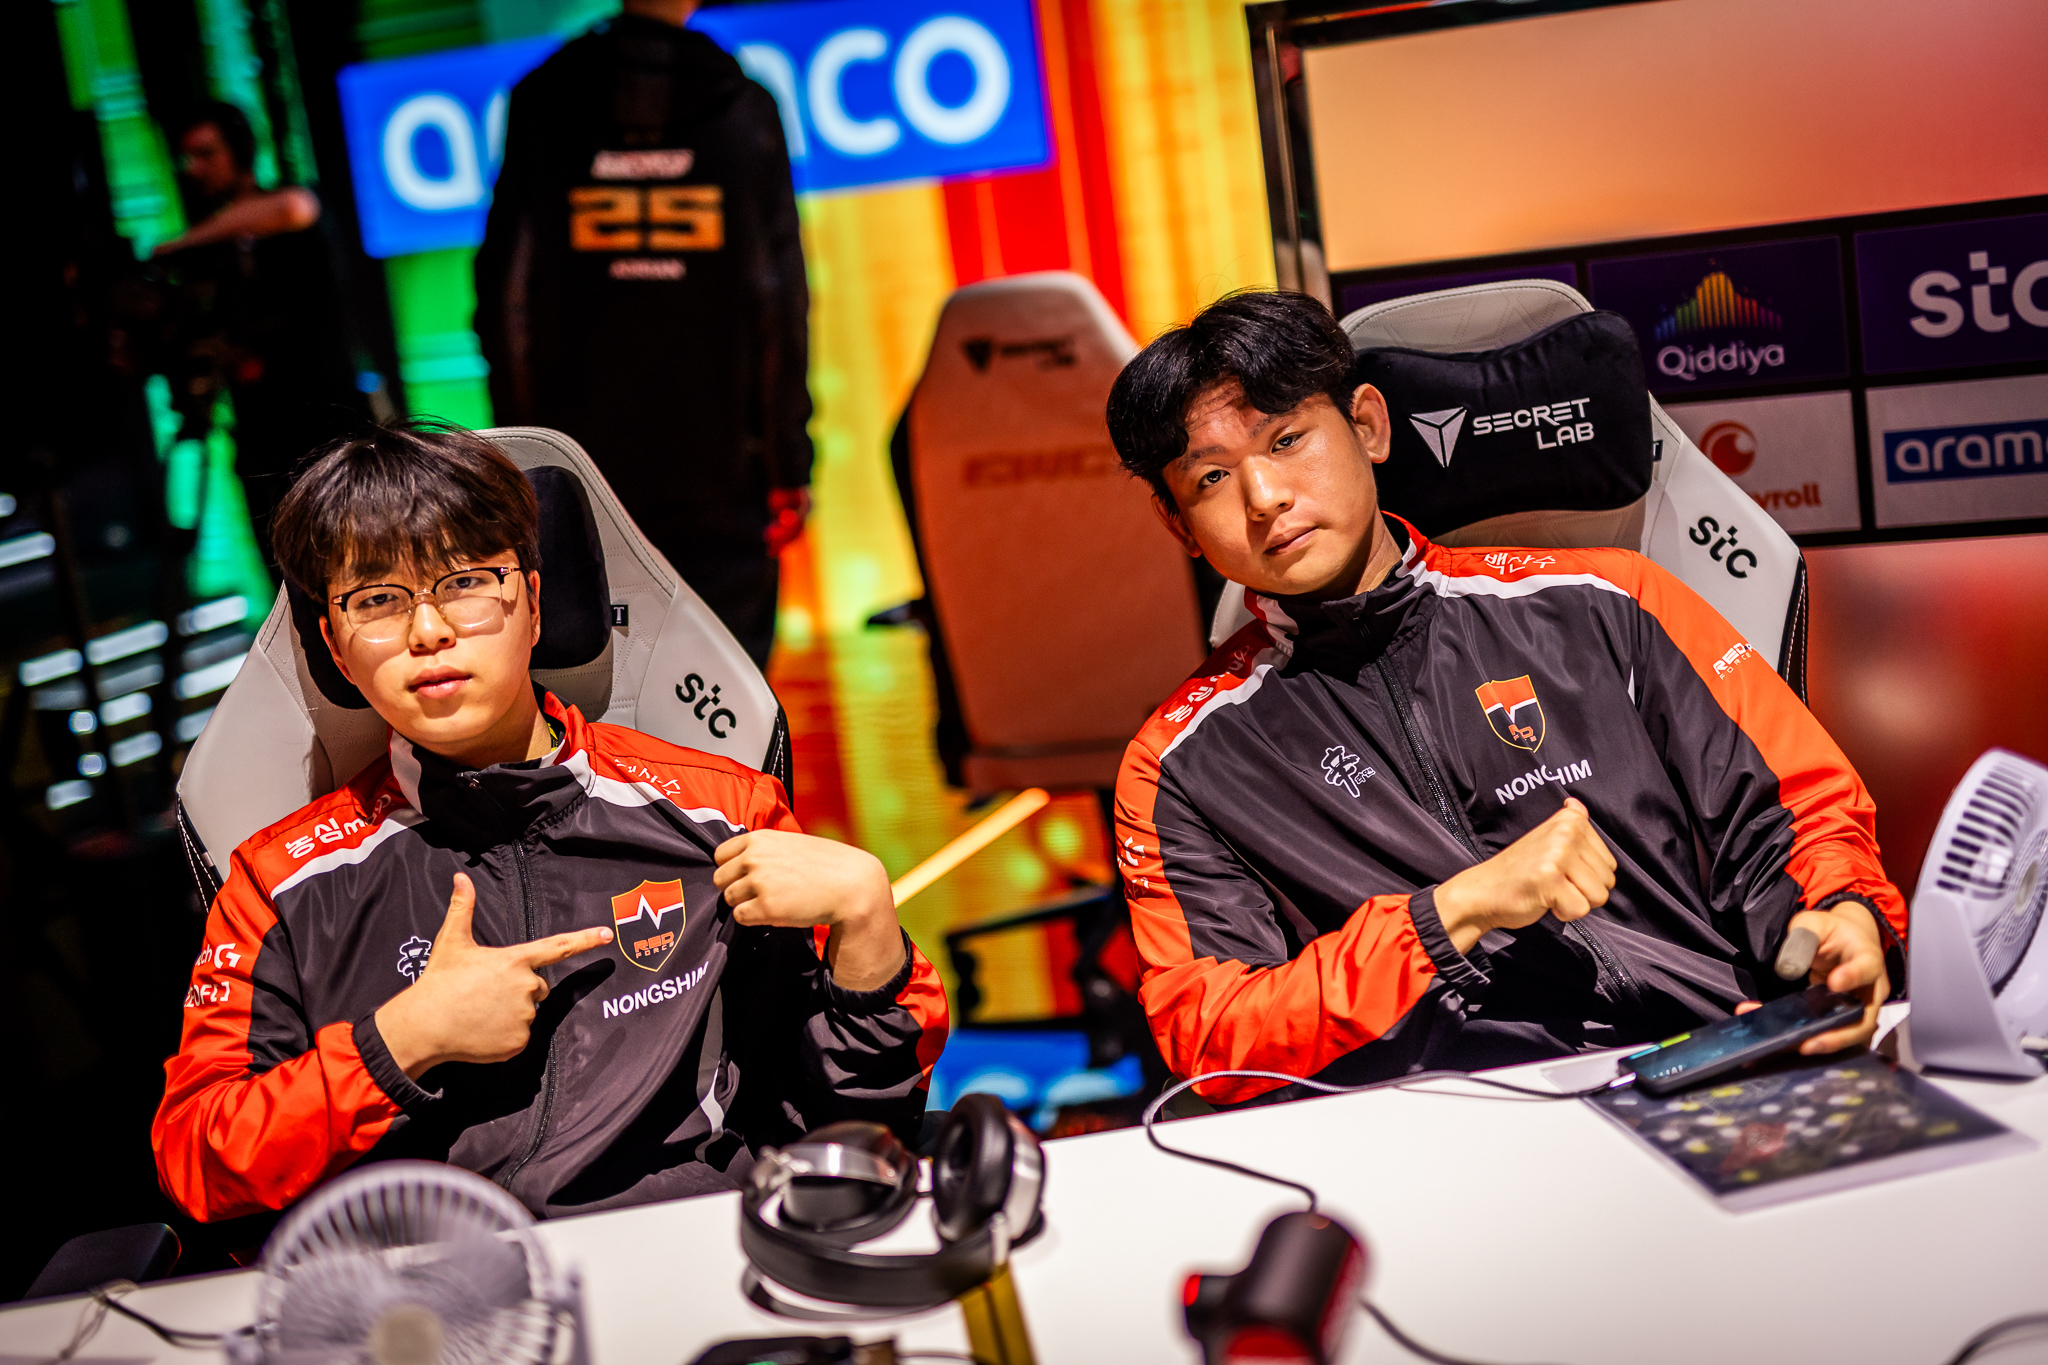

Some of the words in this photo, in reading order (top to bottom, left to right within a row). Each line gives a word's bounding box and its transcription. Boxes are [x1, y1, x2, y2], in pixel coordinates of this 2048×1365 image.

[567, 184, 725, 251] 25
[1657, 340, 1785, 381] Qiddiya
[1473, 398, 1590, 435] SECRET
[1536, 422, 1595, 450] LAB
[1895, 430, 2048, 473] aram
[1484, 553, 1556, 575] 백산수
[1689, 516, 1758, 579] stc
[675, 673, 737, 739] stc
[634, 931, 675, 952] RED
[635, 941, 675, 959] FORCE
